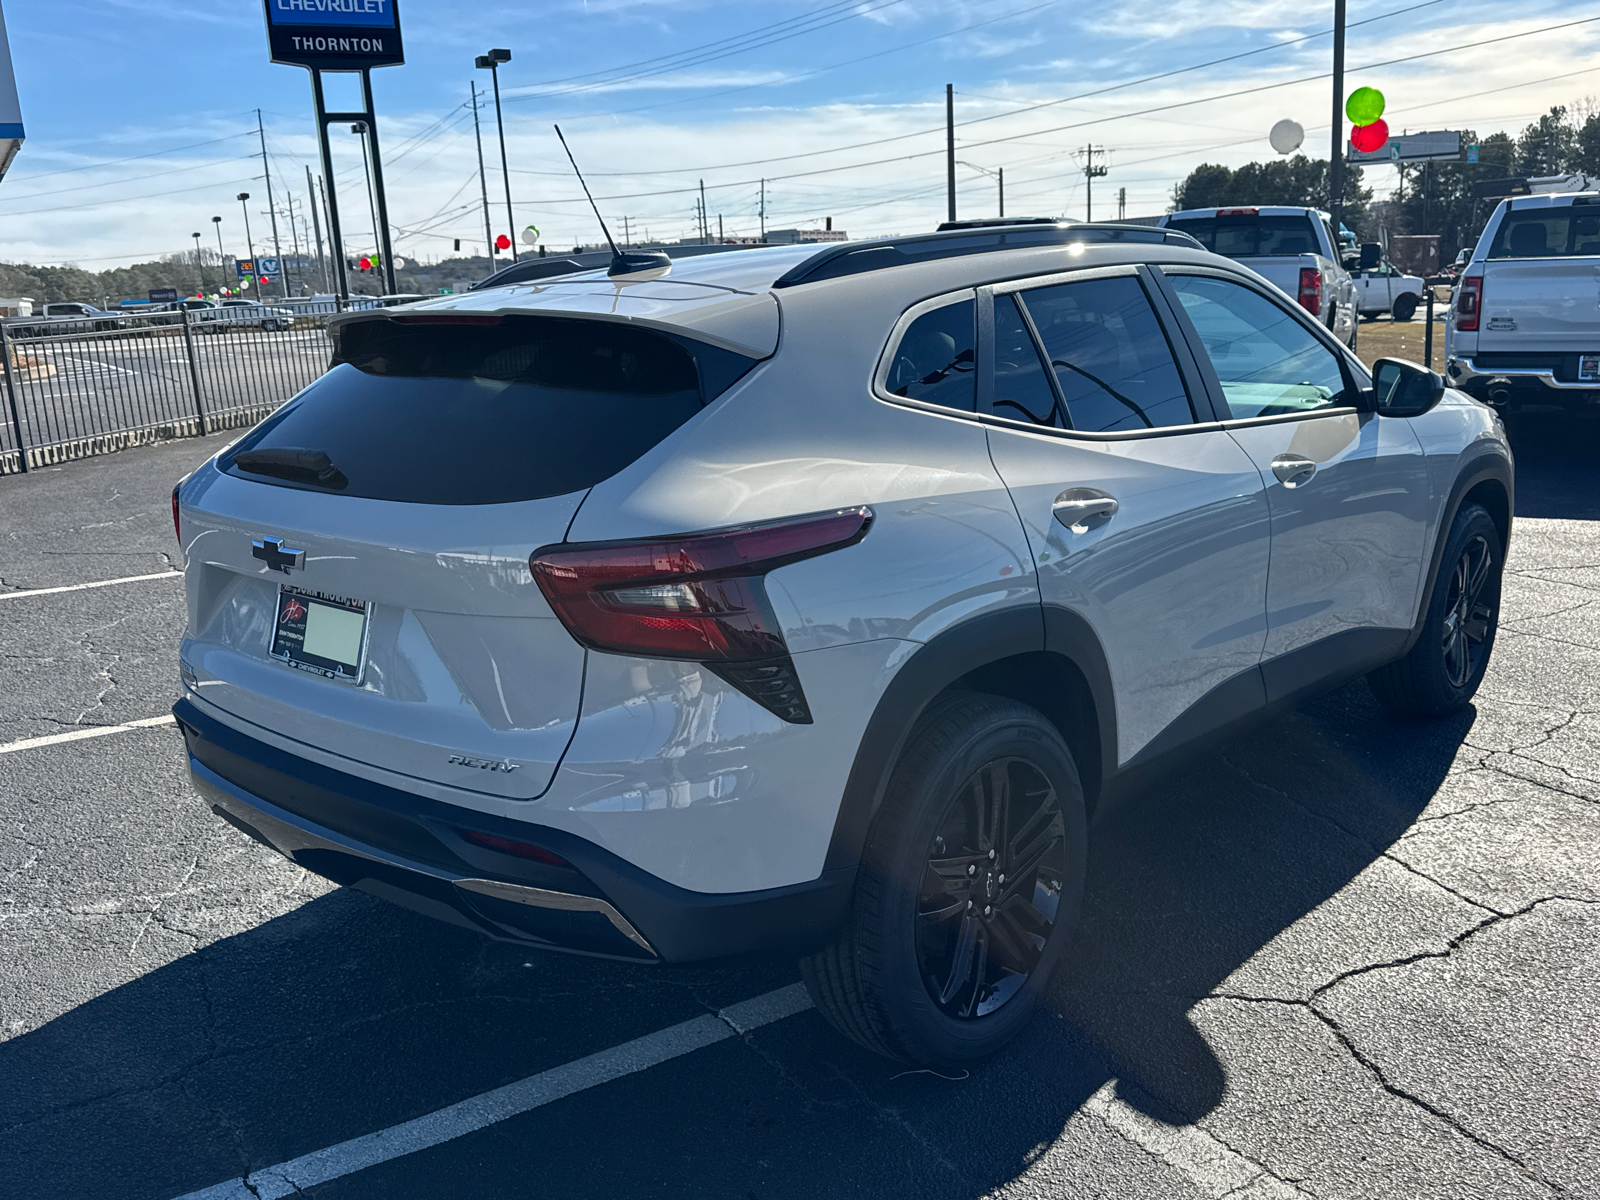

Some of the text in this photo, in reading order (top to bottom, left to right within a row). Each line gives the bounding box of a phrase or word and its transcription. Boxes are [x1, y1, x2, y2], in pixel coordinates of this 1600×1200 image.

[277, 0, 386, 13] CHEVROLET
[292, 37, 383, 52] THORNTON
[298, 663, 325, 676] CHEVROLET
